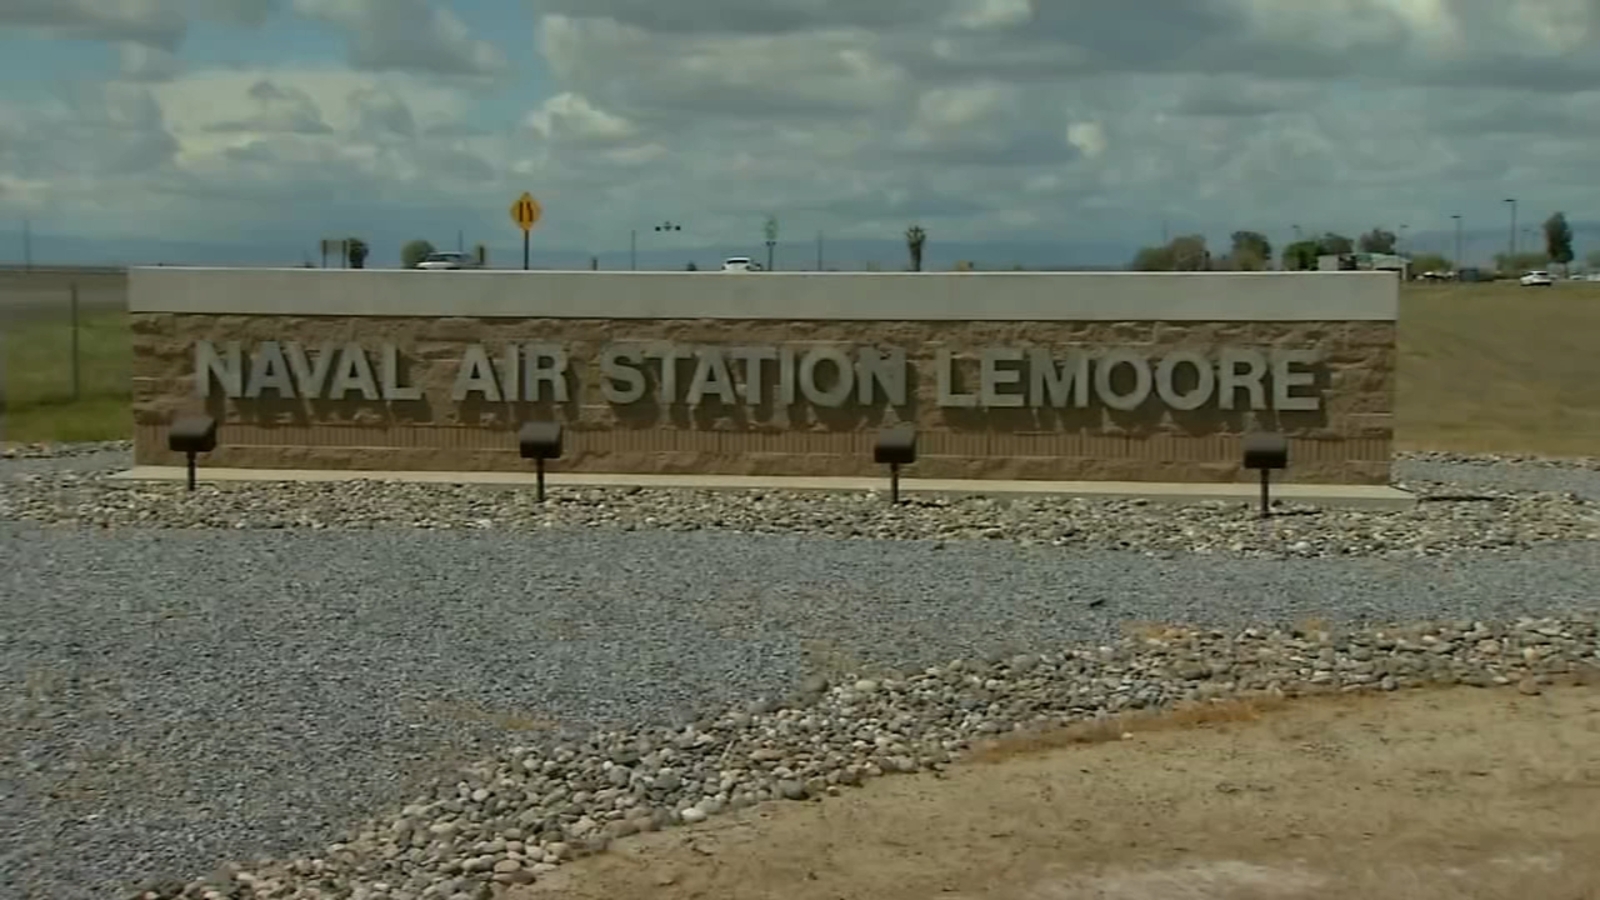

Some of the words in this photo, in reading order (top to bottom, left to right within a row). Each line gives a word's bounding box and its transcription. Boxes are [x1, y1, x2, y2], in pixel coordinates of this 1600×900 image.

[194, 340, 422, 401] NAVAL
[452, 342, 568, 403] AIR
[600, 345, 906, 409] STATION
[936, 347, 1320, 412] LEMOORE
